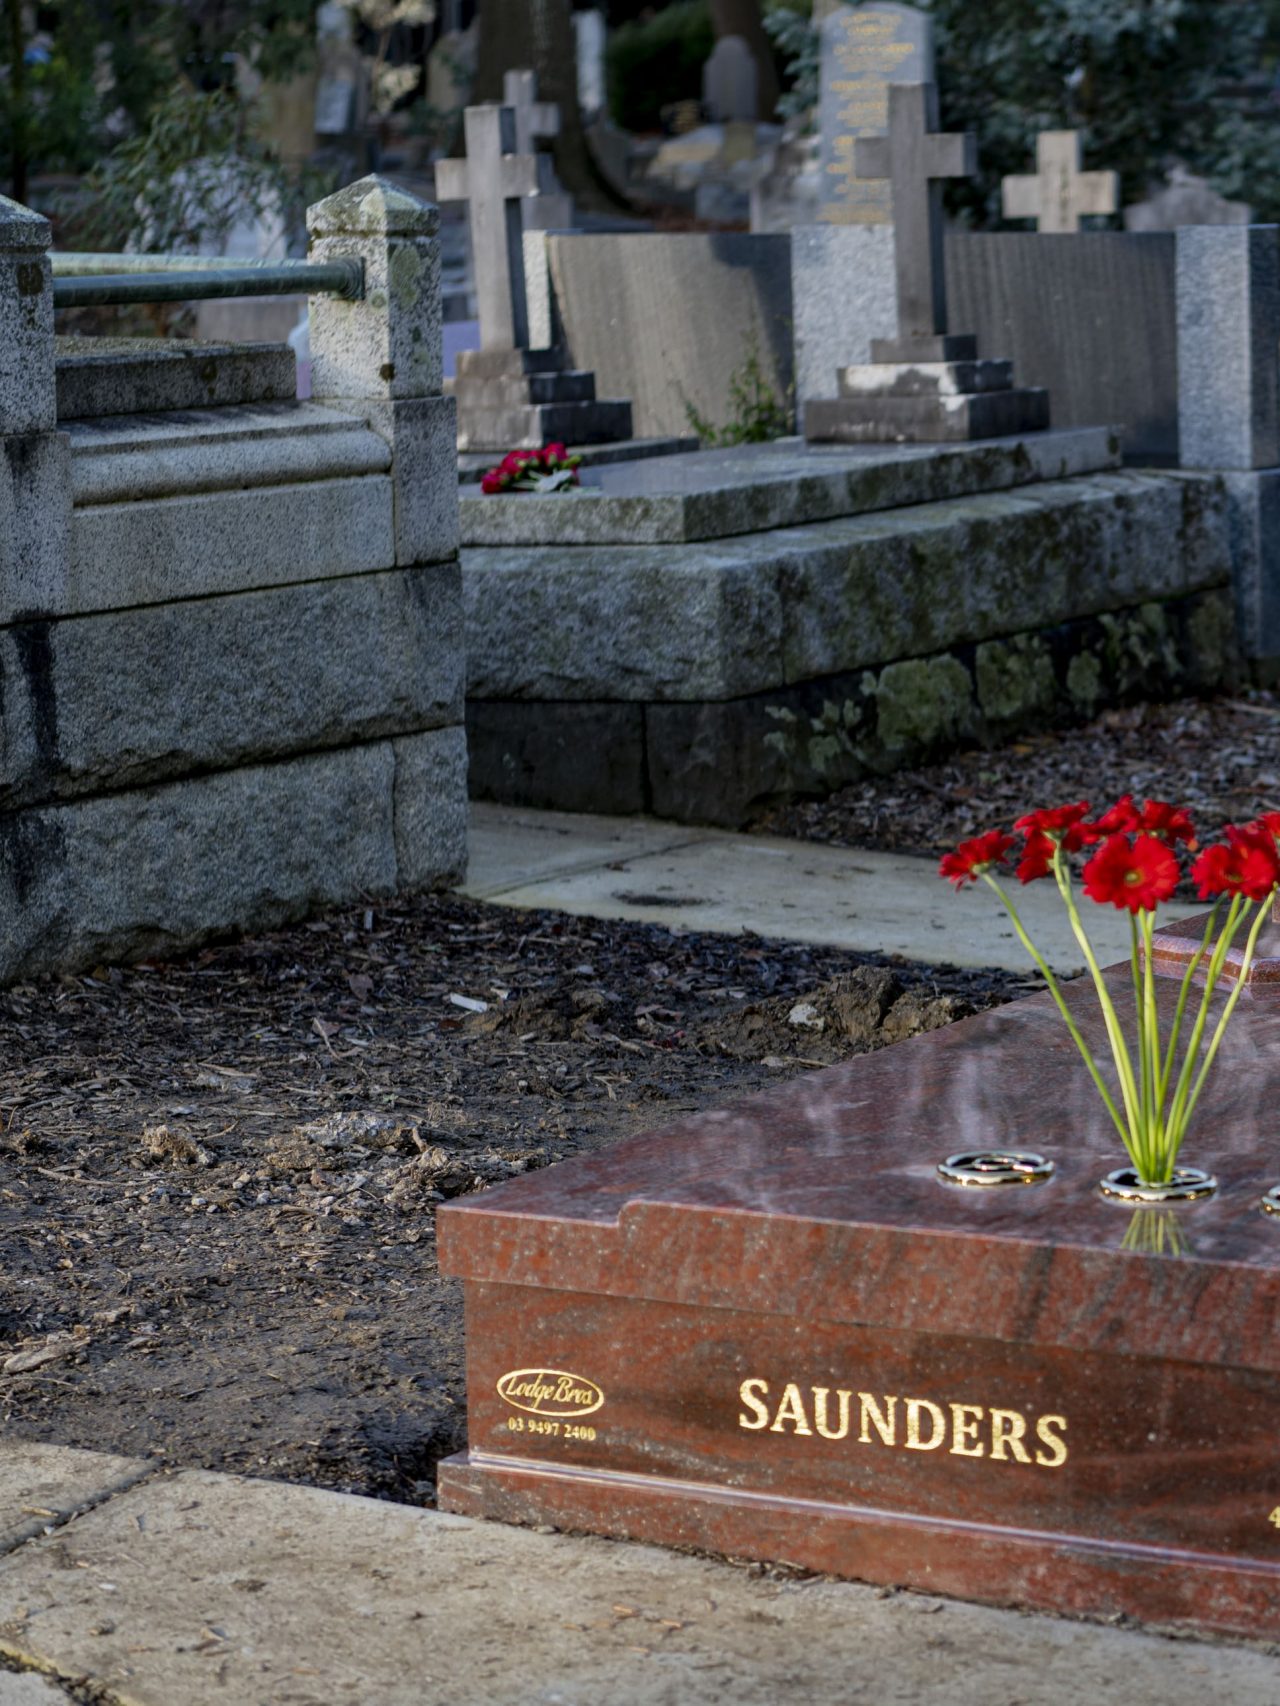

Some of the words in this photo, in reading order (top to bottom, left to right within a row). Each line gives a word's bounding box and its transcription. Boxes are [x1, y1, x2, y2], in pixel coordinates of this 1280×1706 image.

[506, 1372, 555, 1409] Lodge
[552, 1376, 593, 1405] Bros
[508, 1417, 524, 1432] 03
[528, 1419, 560, 1436] 9497
[564, 1423, 597, 1441] 2400
[739, 1378, 1068, 1468] SAUNDERS
